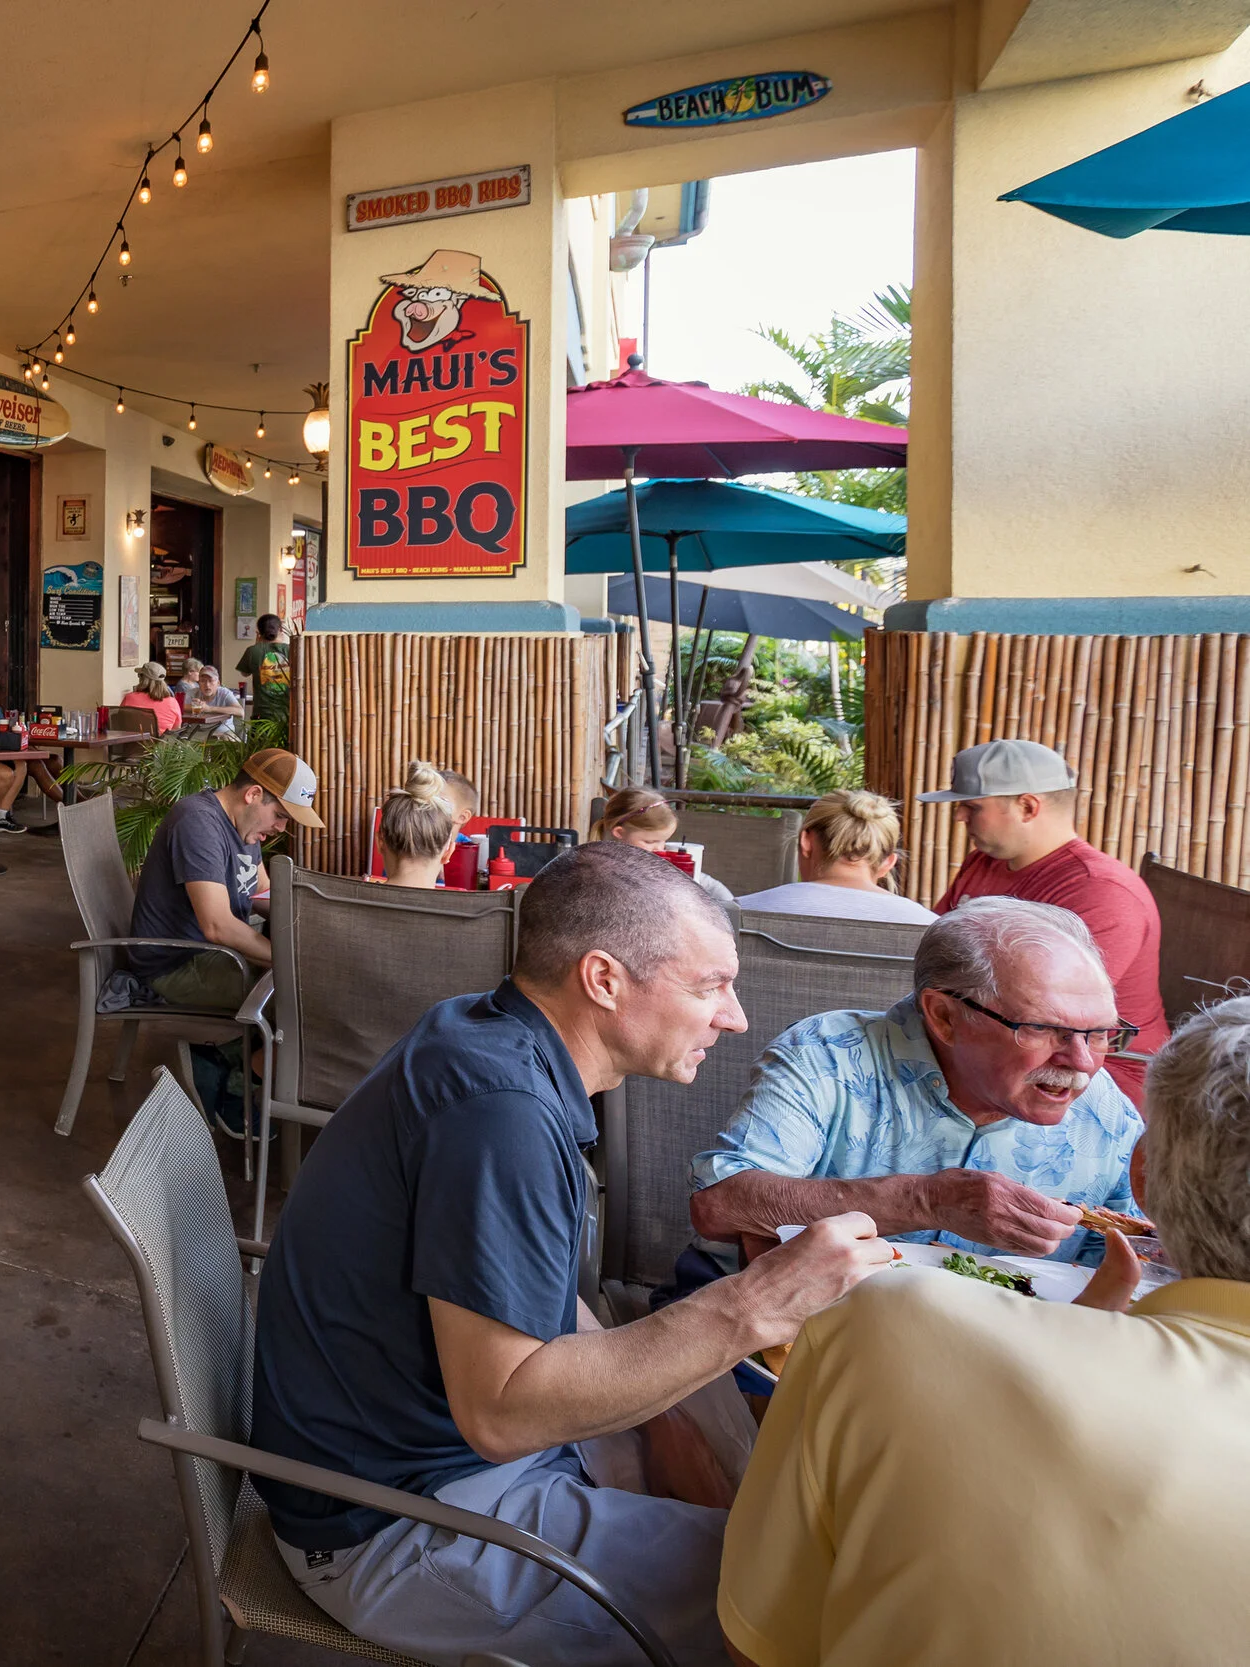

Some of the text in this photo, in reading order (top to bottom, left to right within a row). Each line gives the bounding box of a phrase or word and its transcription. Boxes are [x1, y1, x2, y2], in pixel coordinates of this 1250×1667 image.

[658, 75, 816, 121] BEACH BUM
[355, 173, 522, 223] SMOKED BBQ RIBS
[363, 348, 518, 397] MAUI'S
[358, 401, 517, 471] BEST
[357, 481, 517, 554] BBQ
